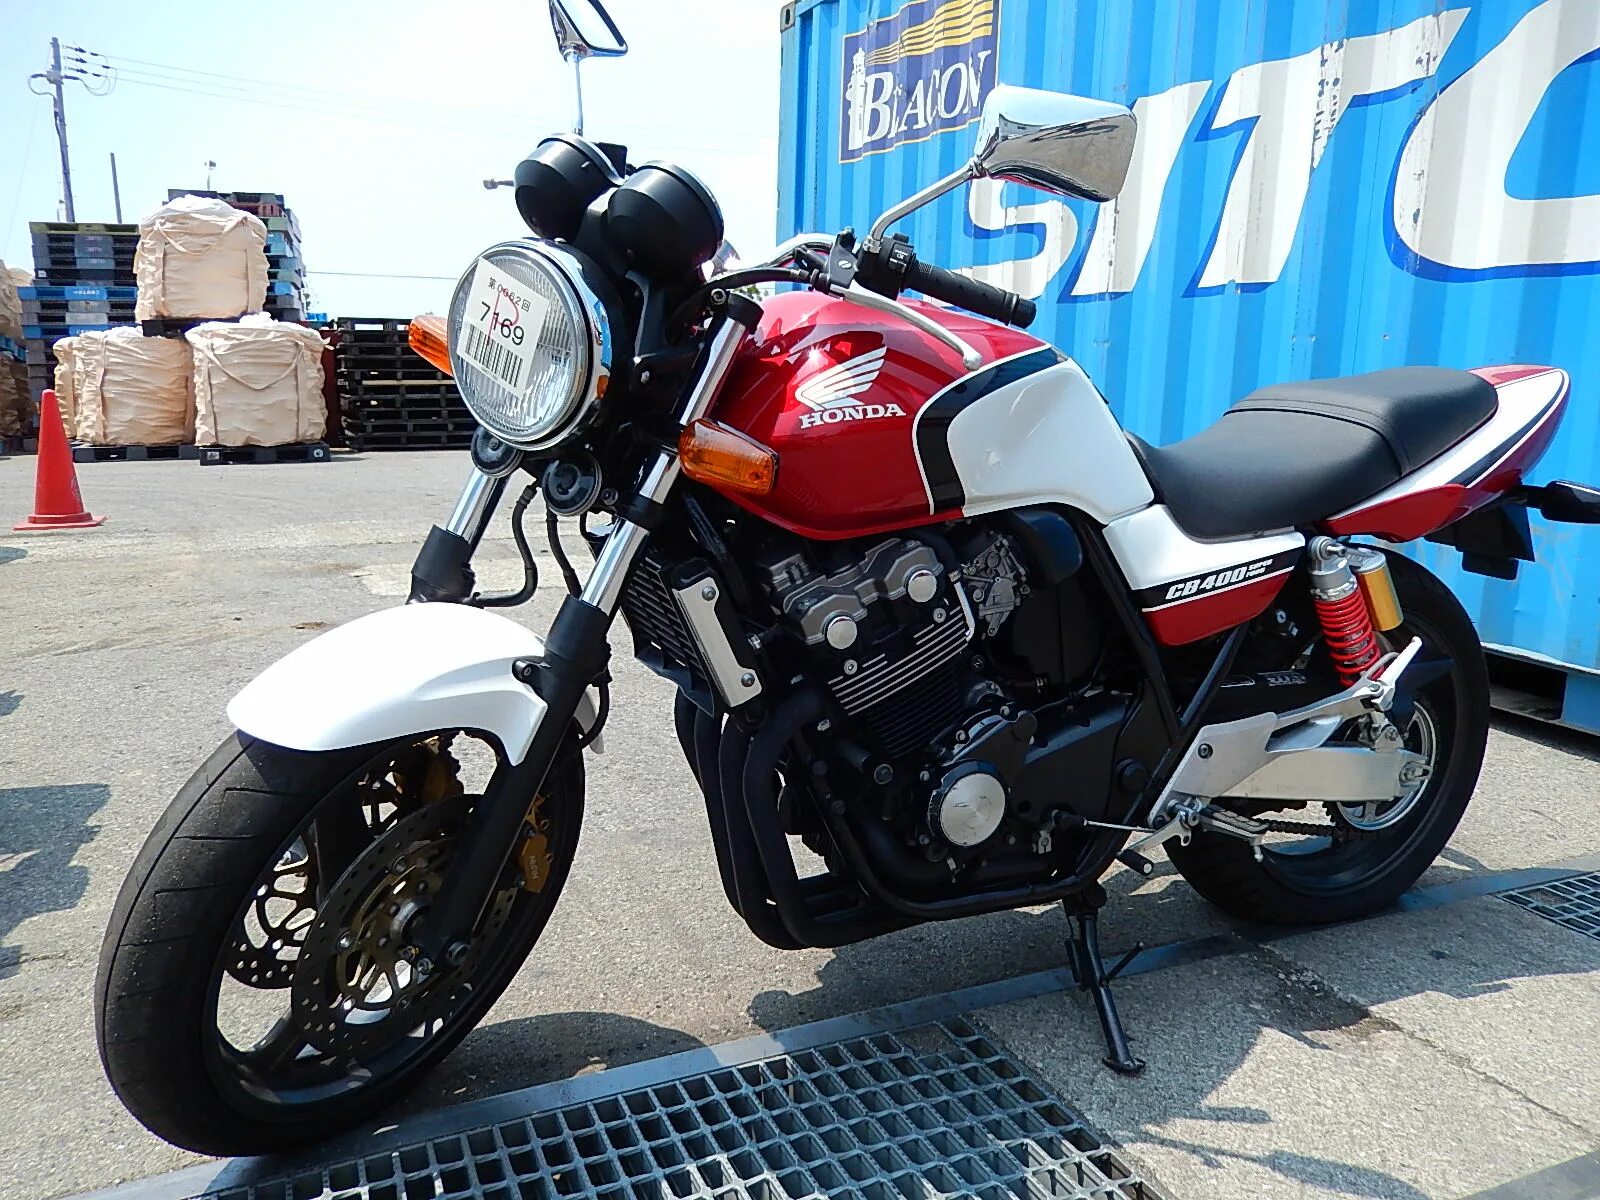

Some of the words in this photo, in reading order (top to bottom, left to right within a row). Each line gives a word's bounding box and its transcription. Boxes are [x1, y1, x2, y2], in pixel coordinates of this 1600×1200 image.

[863, 50, 992, 144] BEACON
[480, 301, 525, 346] 7169
[799, 403, 907, 428] HONDA
[1165, 566, 1248, 600] CB400
